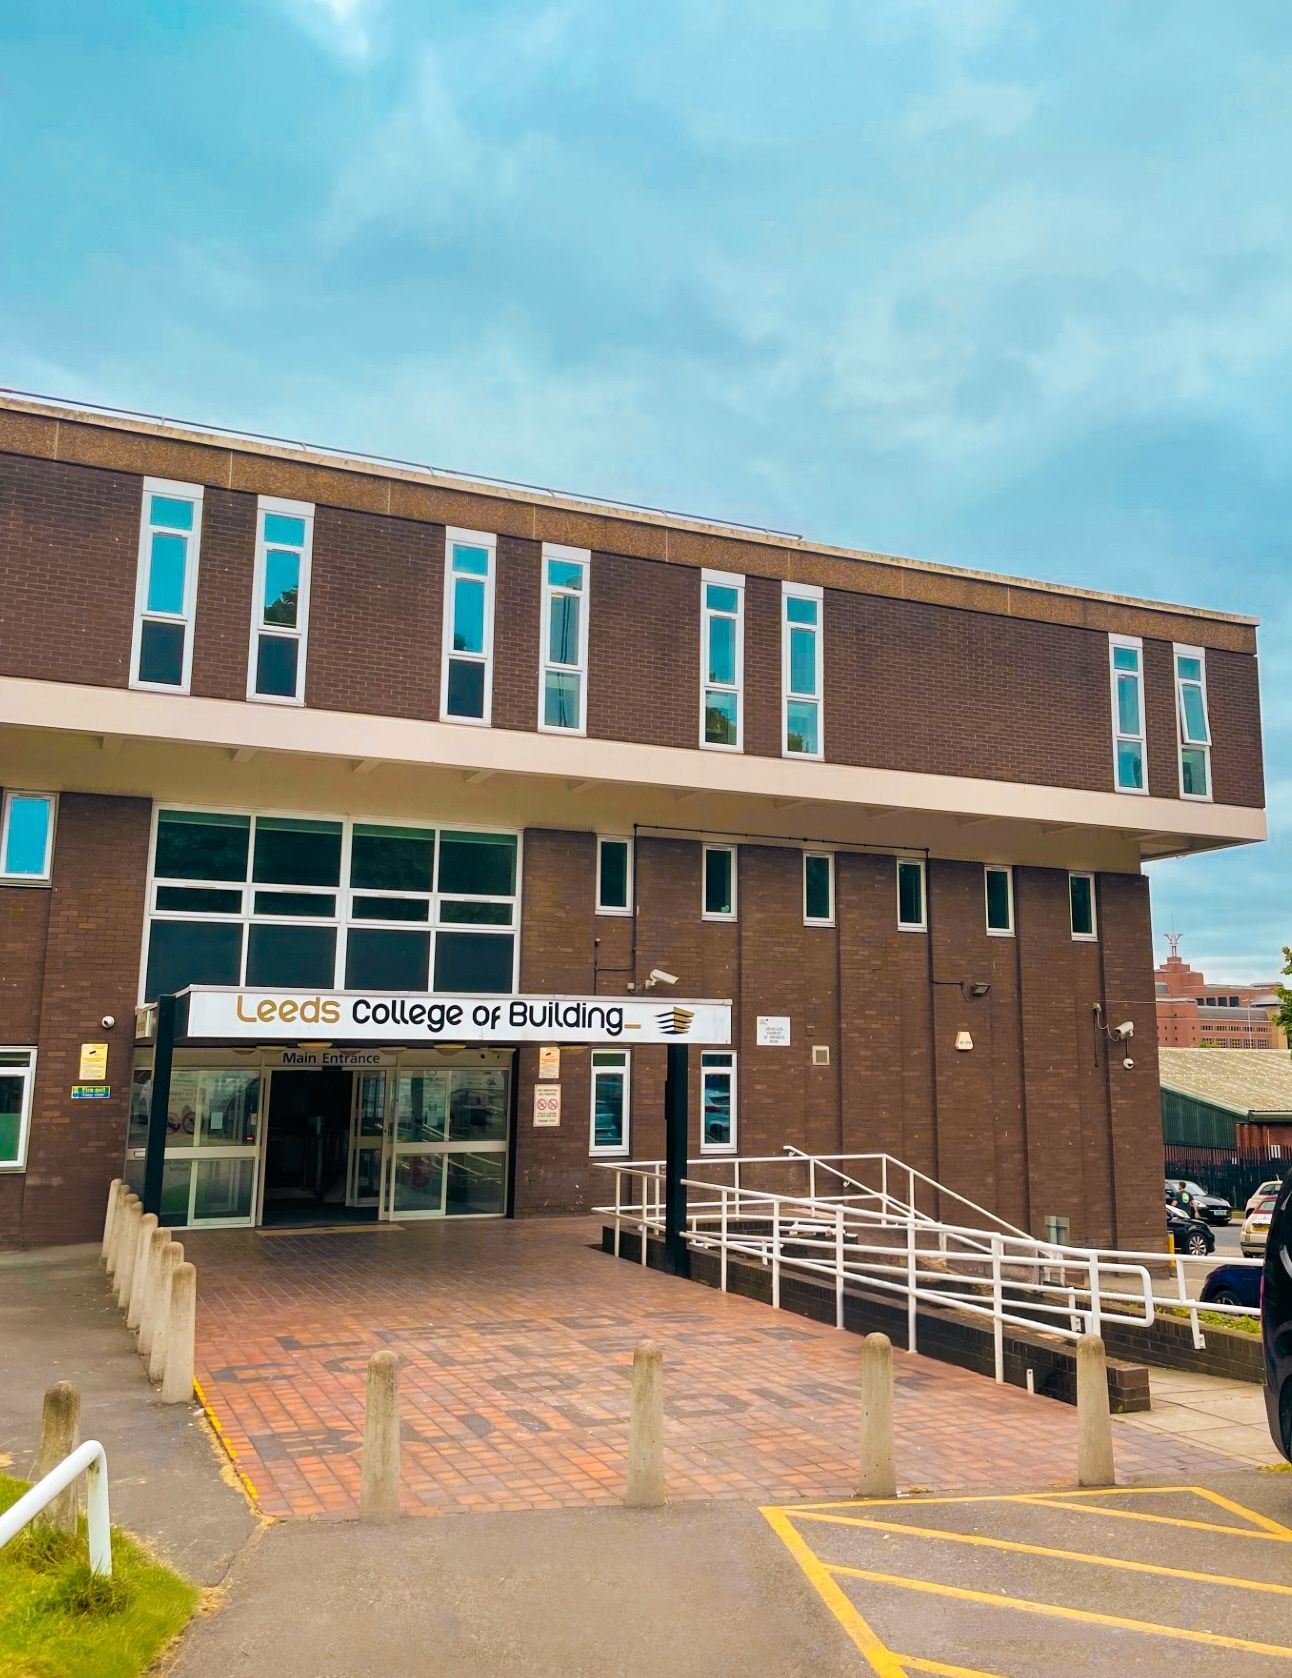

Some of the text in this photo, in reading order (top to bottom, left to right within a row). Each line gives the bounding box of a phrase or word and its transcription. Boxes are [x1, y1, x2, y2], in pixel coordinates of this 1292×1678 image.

[236, 995, 341, 1024] Leeds
[352, 998, 463, 1033] College
[472, 1004, 501, 1029] of
[282, 1052, 380, 1064] Main Entrance
